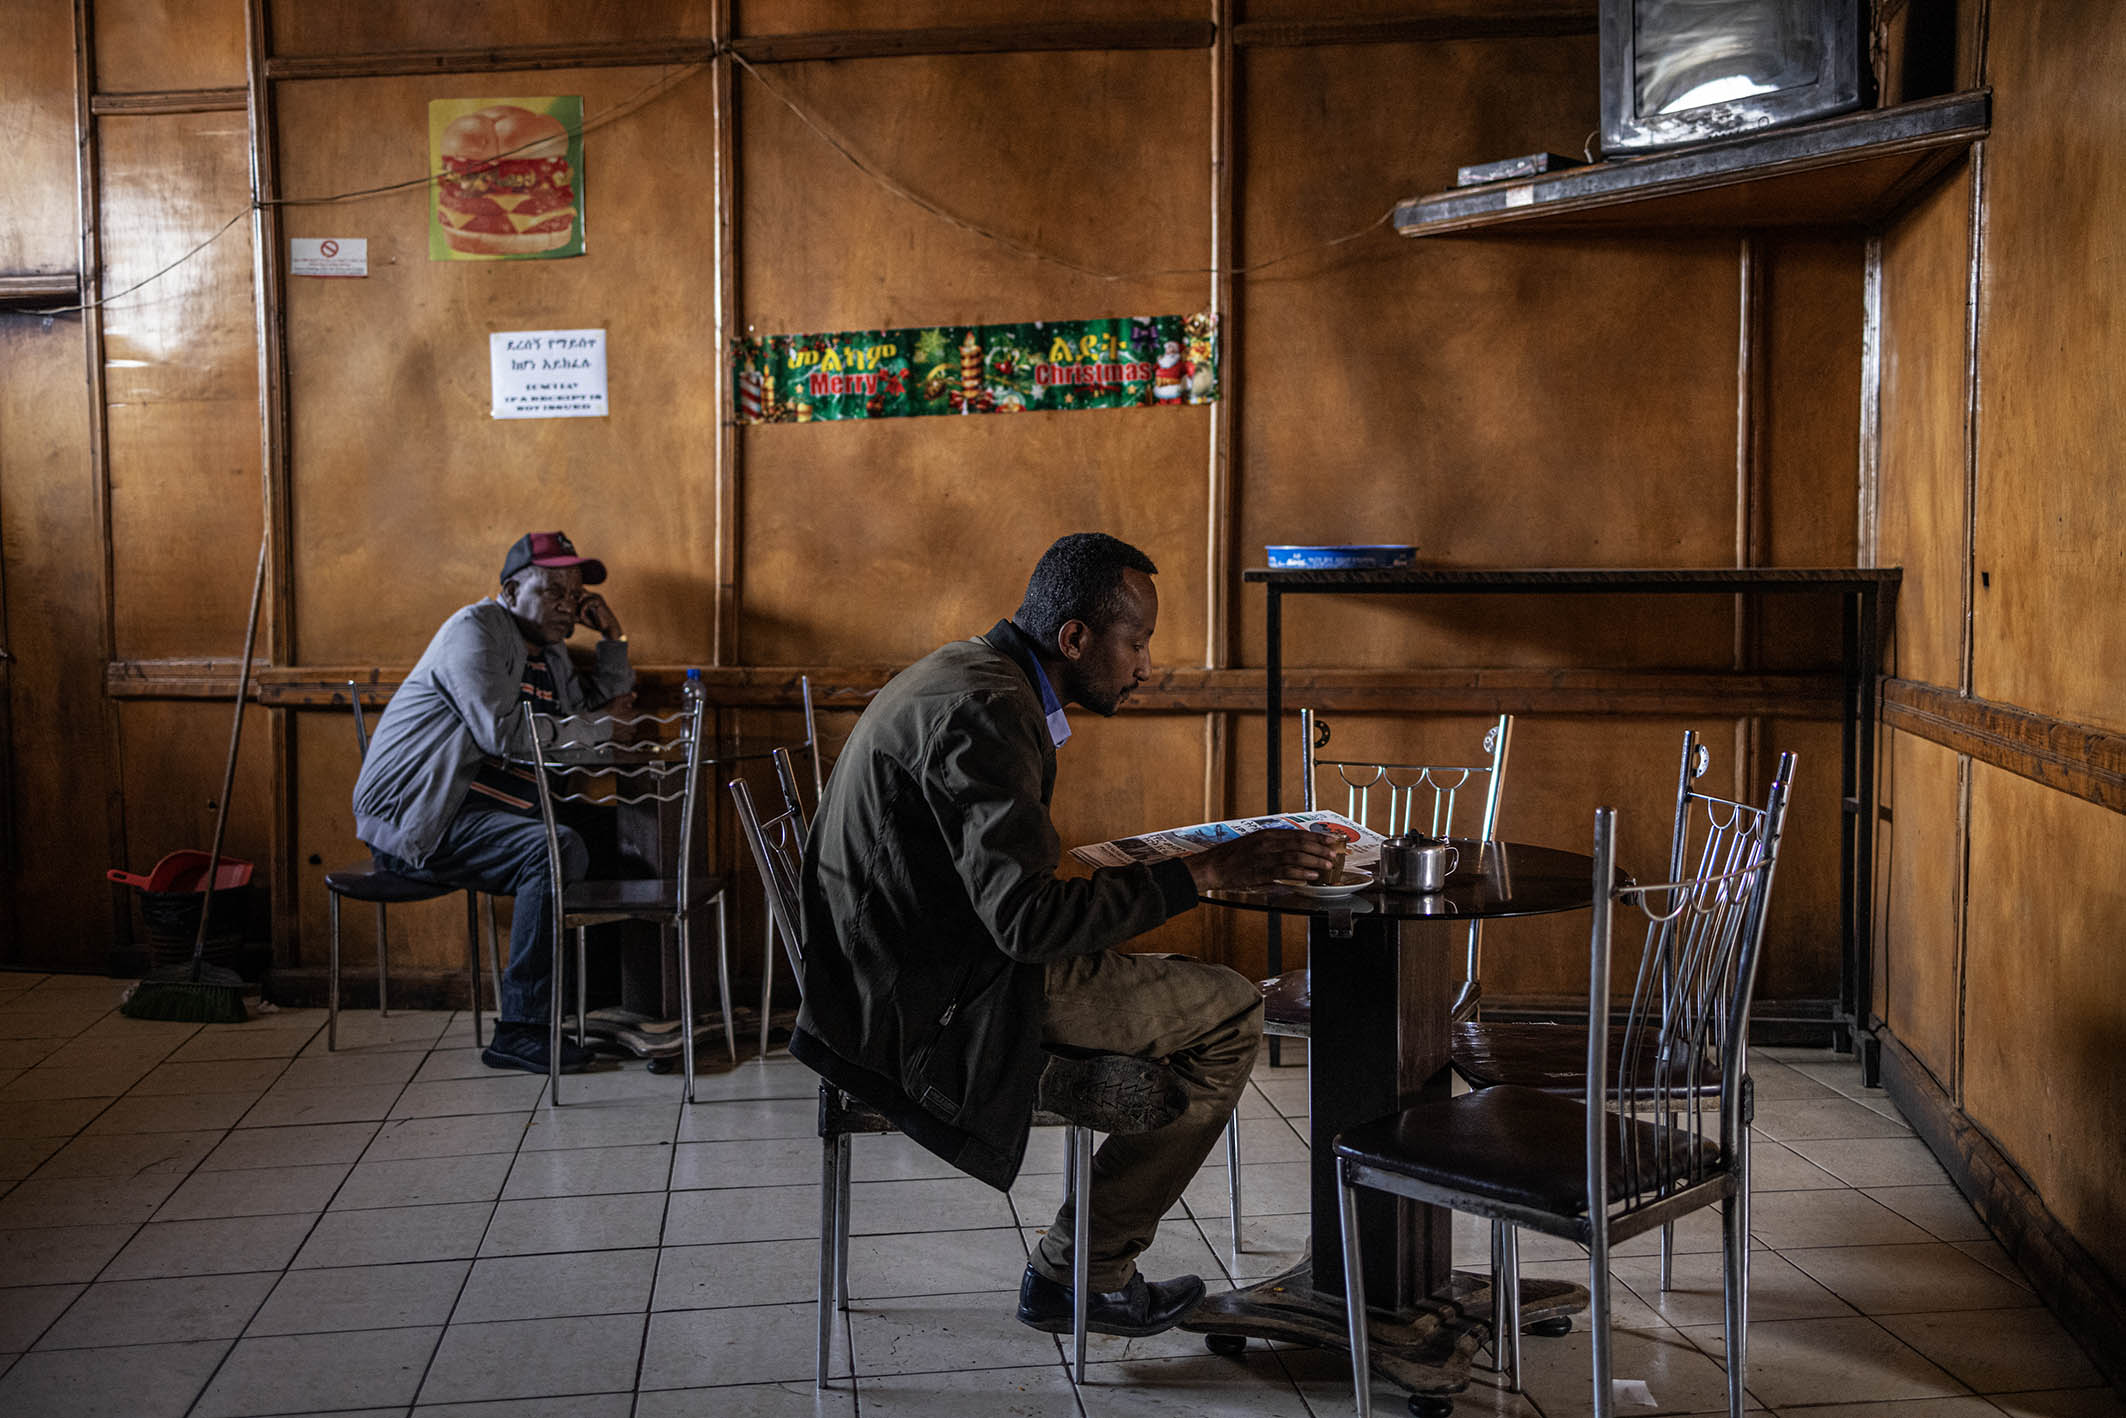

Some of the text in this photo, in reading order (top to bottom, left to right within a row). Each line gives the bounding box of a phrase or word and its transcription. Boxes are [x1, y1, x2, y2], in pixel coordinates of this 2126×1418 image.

[788, 333, 1128, 372] መልካም ልደት
[810, 361, 1152, 396] Merry Christmas
